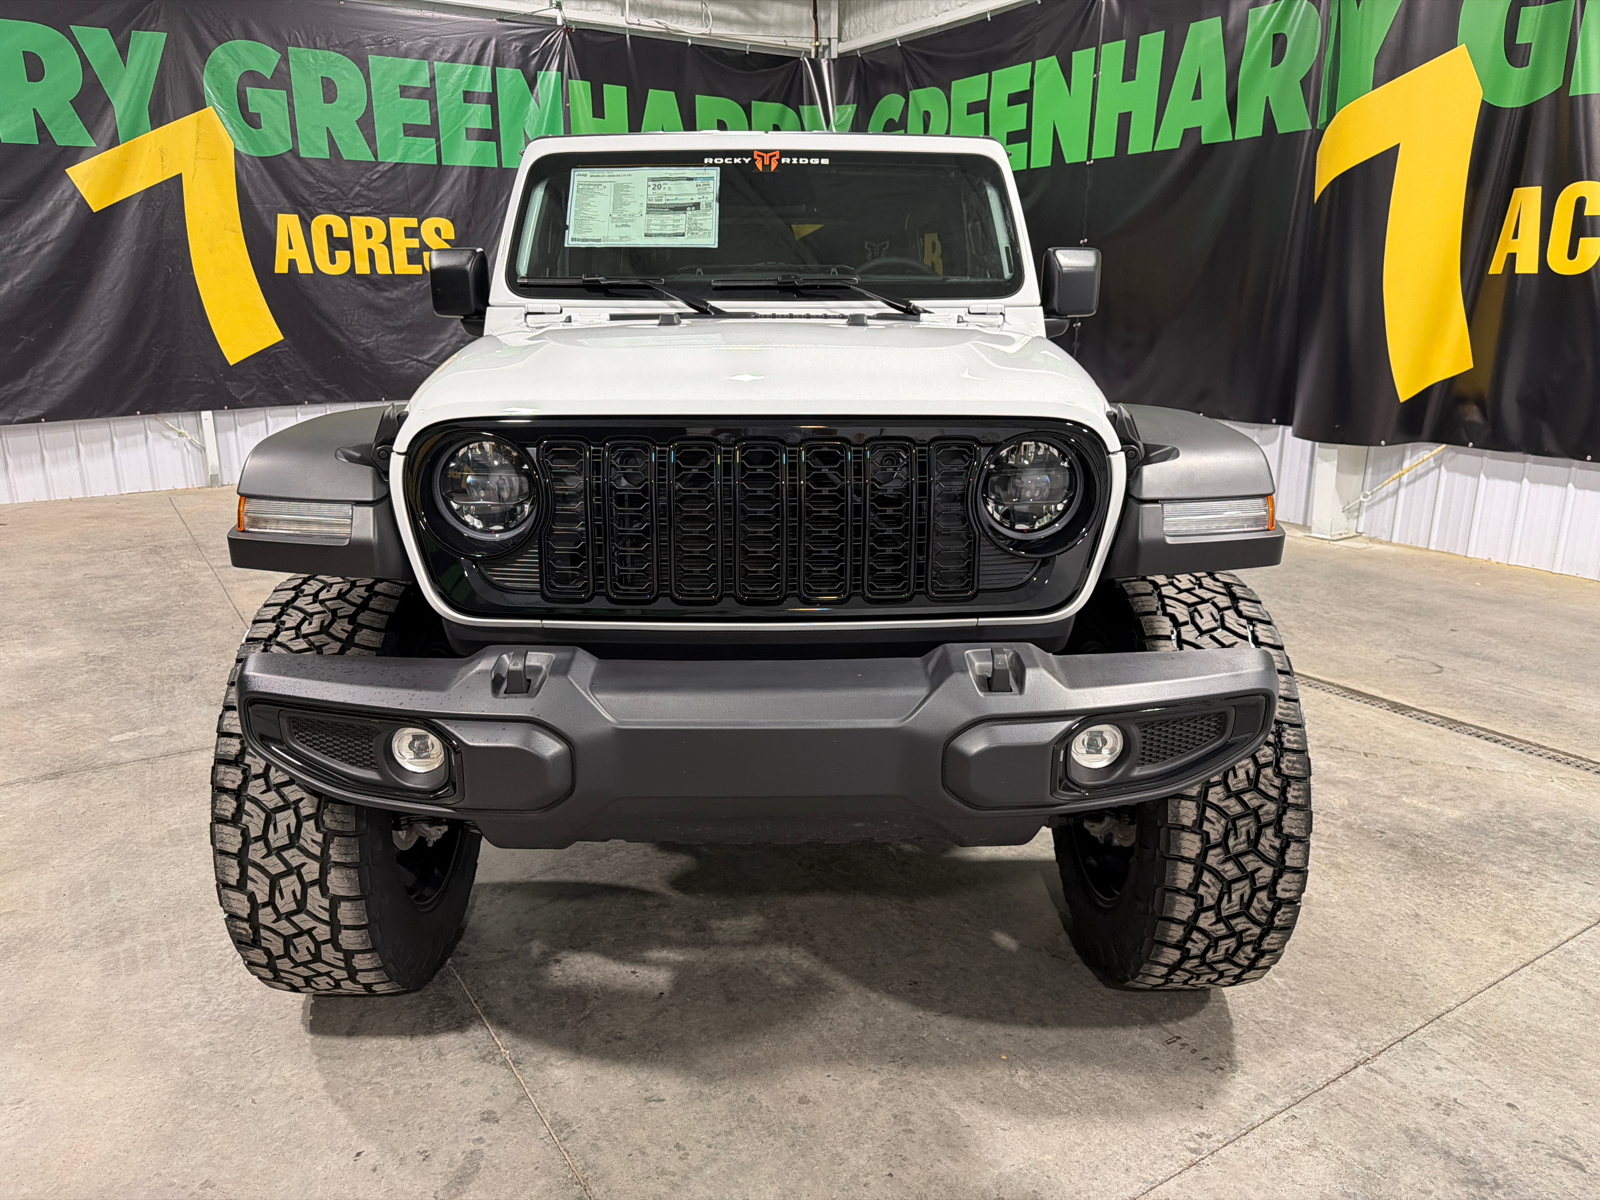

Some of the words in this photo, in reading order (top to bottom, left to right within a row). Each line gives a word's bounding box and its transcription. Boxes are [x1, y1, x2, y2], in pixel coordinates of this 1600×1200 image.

[204, 40, 563, 168] GREEN
[1457, 0, 1600, 108] G
[66, 106, 284, 365] 7
[274, 213, 456, 275] ACRES
[652, 183, 662, 191] 20
[1314, 43, 1483, 403] 7
[1488, 181, 1600, 275] AC
